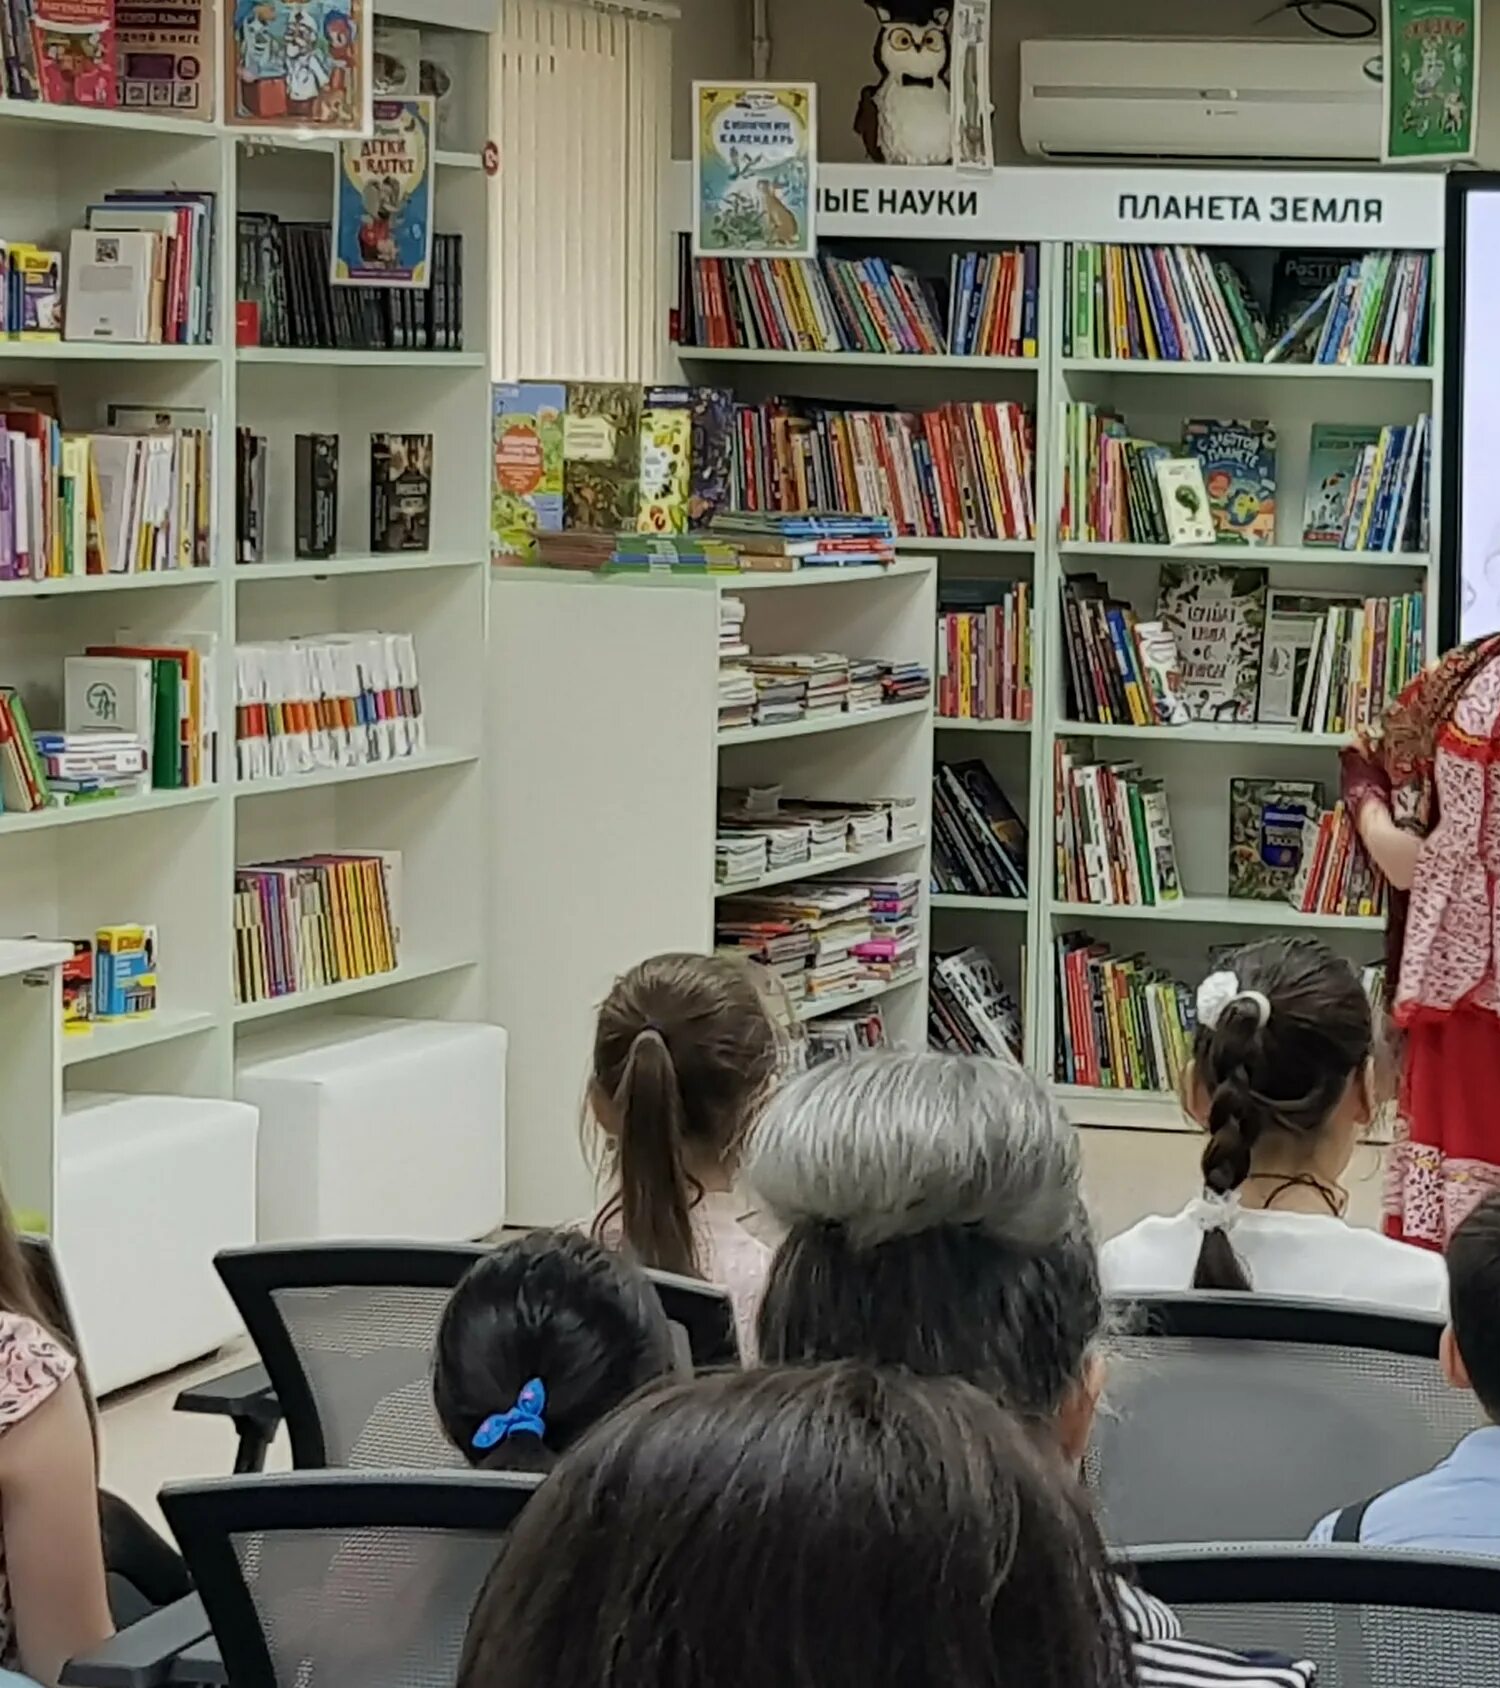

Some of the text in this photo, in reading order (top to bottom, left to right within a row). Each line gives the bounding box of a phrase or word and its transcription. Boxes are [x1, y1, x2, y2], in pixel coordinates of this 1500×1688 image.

[816, 187, 978, 216] ЫЕ НАУКИ
[1118, 194, 1384, 224] ПЛАНЕТА ЗЕМЛЯ
